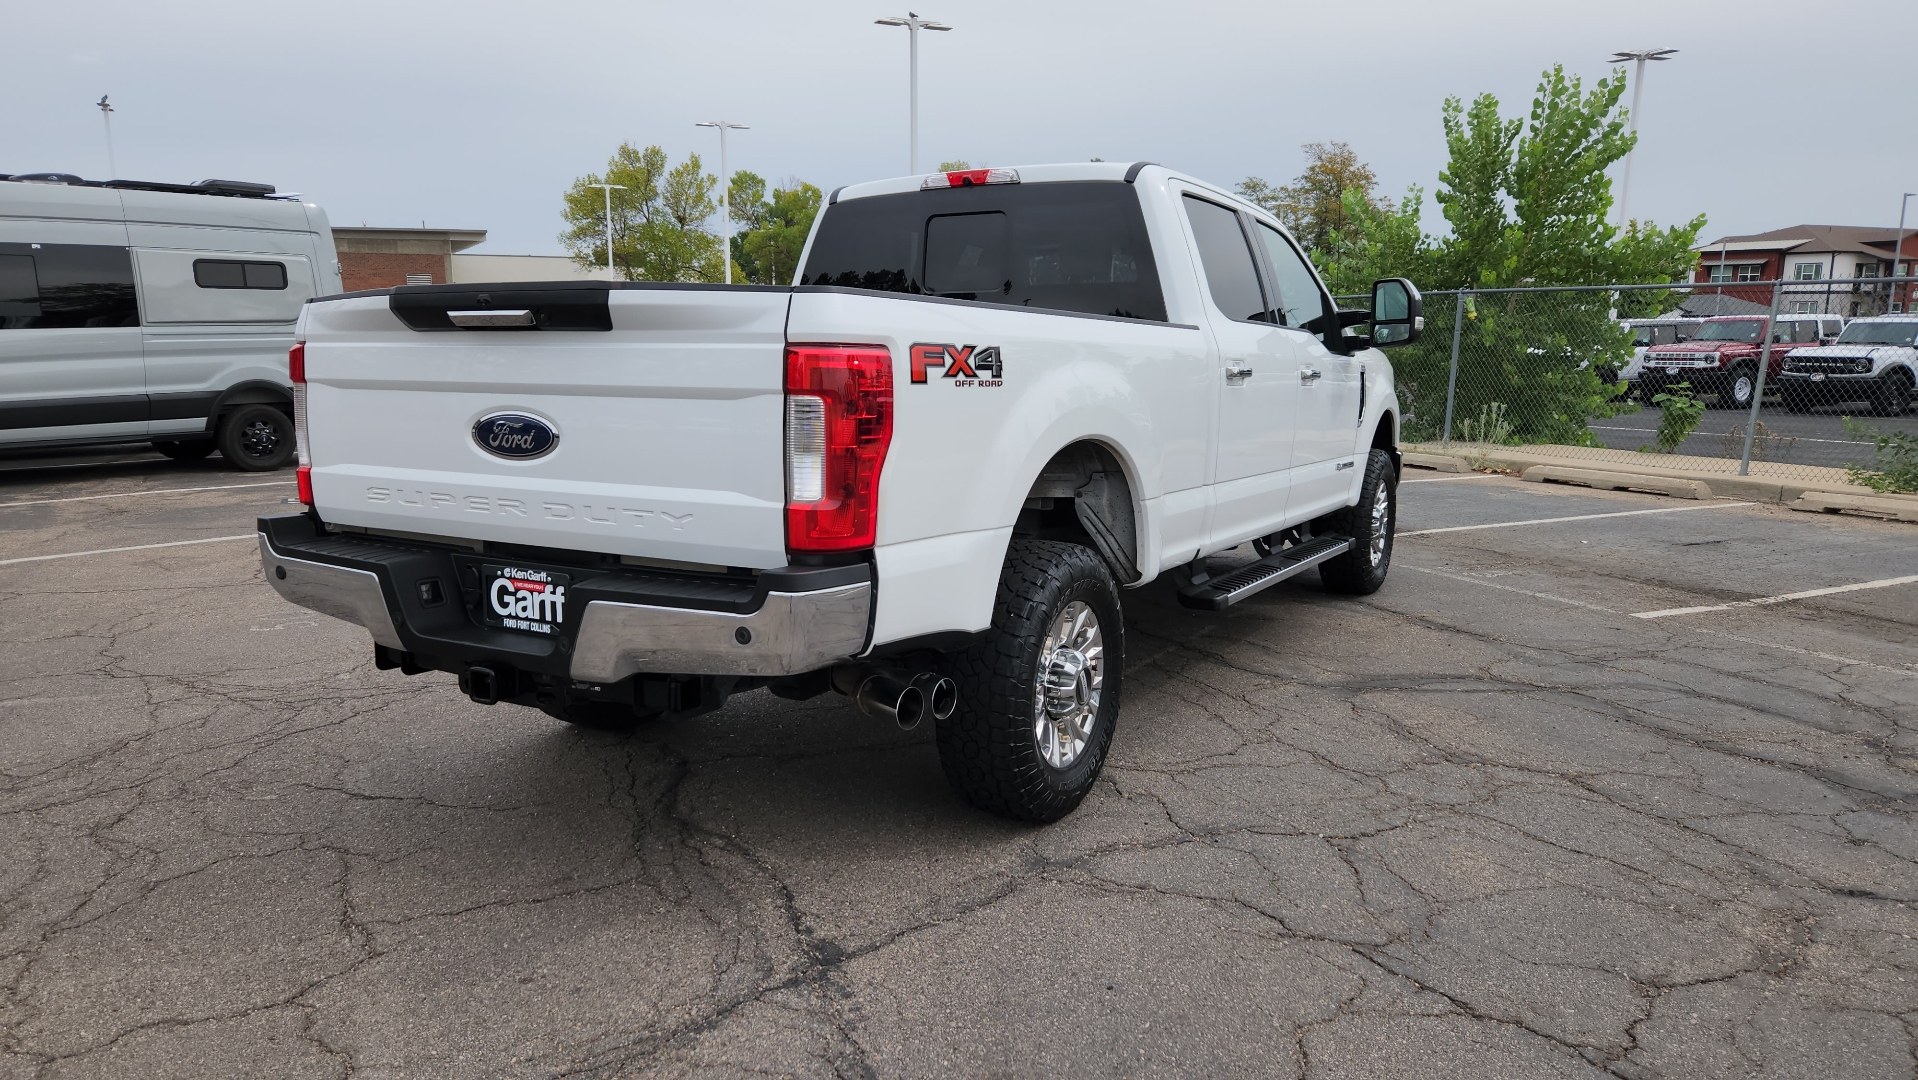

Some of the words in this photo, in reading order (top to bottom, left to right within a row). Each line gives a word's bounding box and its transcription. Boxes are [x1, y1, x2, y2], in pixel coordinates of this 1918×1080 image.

[909, 341, 1003, 385] FX4
[489, 420, 536, 449] Ford
[367, 486, 527, 517] SUPER
[543, 501, 694, 531] DUTY
[511, 568, 527, 580] Ken
[527, 570, 546, 582] Garff
[490, 577, 565, 623] Garff
[503, 619, 516, 628] FORD
[517, 620, 530, 630] FORT
[530, 622, 550, 634] COLLINS
